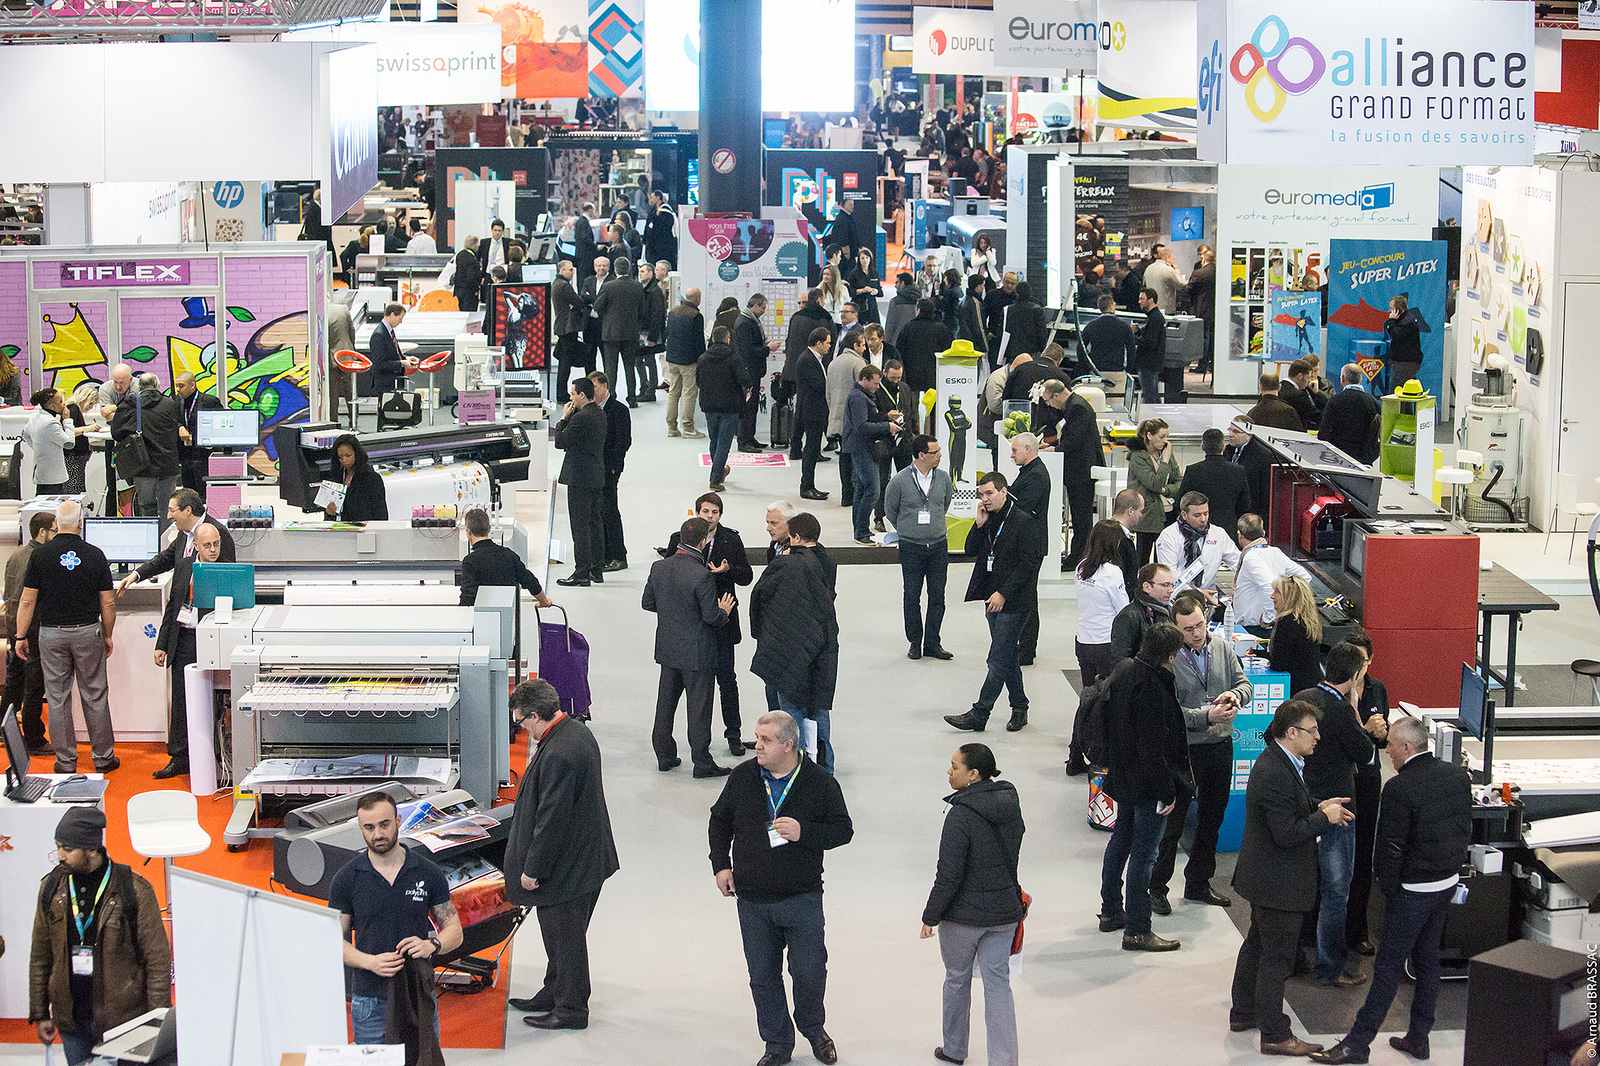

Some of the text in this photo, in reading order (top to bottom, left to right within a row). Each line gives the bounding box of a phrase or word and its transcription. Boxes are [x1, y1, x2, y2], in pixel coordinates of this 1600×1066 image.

[951, 36, 986, 52] DUPLI
[1331, 37, 1527, 89] alliance
[1199, 39, 1223, 126] efi
[1331, 128, 1525, 144] la fusion des savoirs
[215, 181, 240, 209] hp
[1264, 188, 1376, 207] euromedia
[1271, 212, 1328, 225] partenaire
[1333, 211, 1365, 228] grand
[1368, 209, 1412, 224] format
[67, 264, 182, 281] TIFLEX
[1338, 252, 1406, 274] JEU-CONCOURS
[1350, 259, 1439, 290] SUPER LATEX
[945, 377, 967, 385] ESKO
